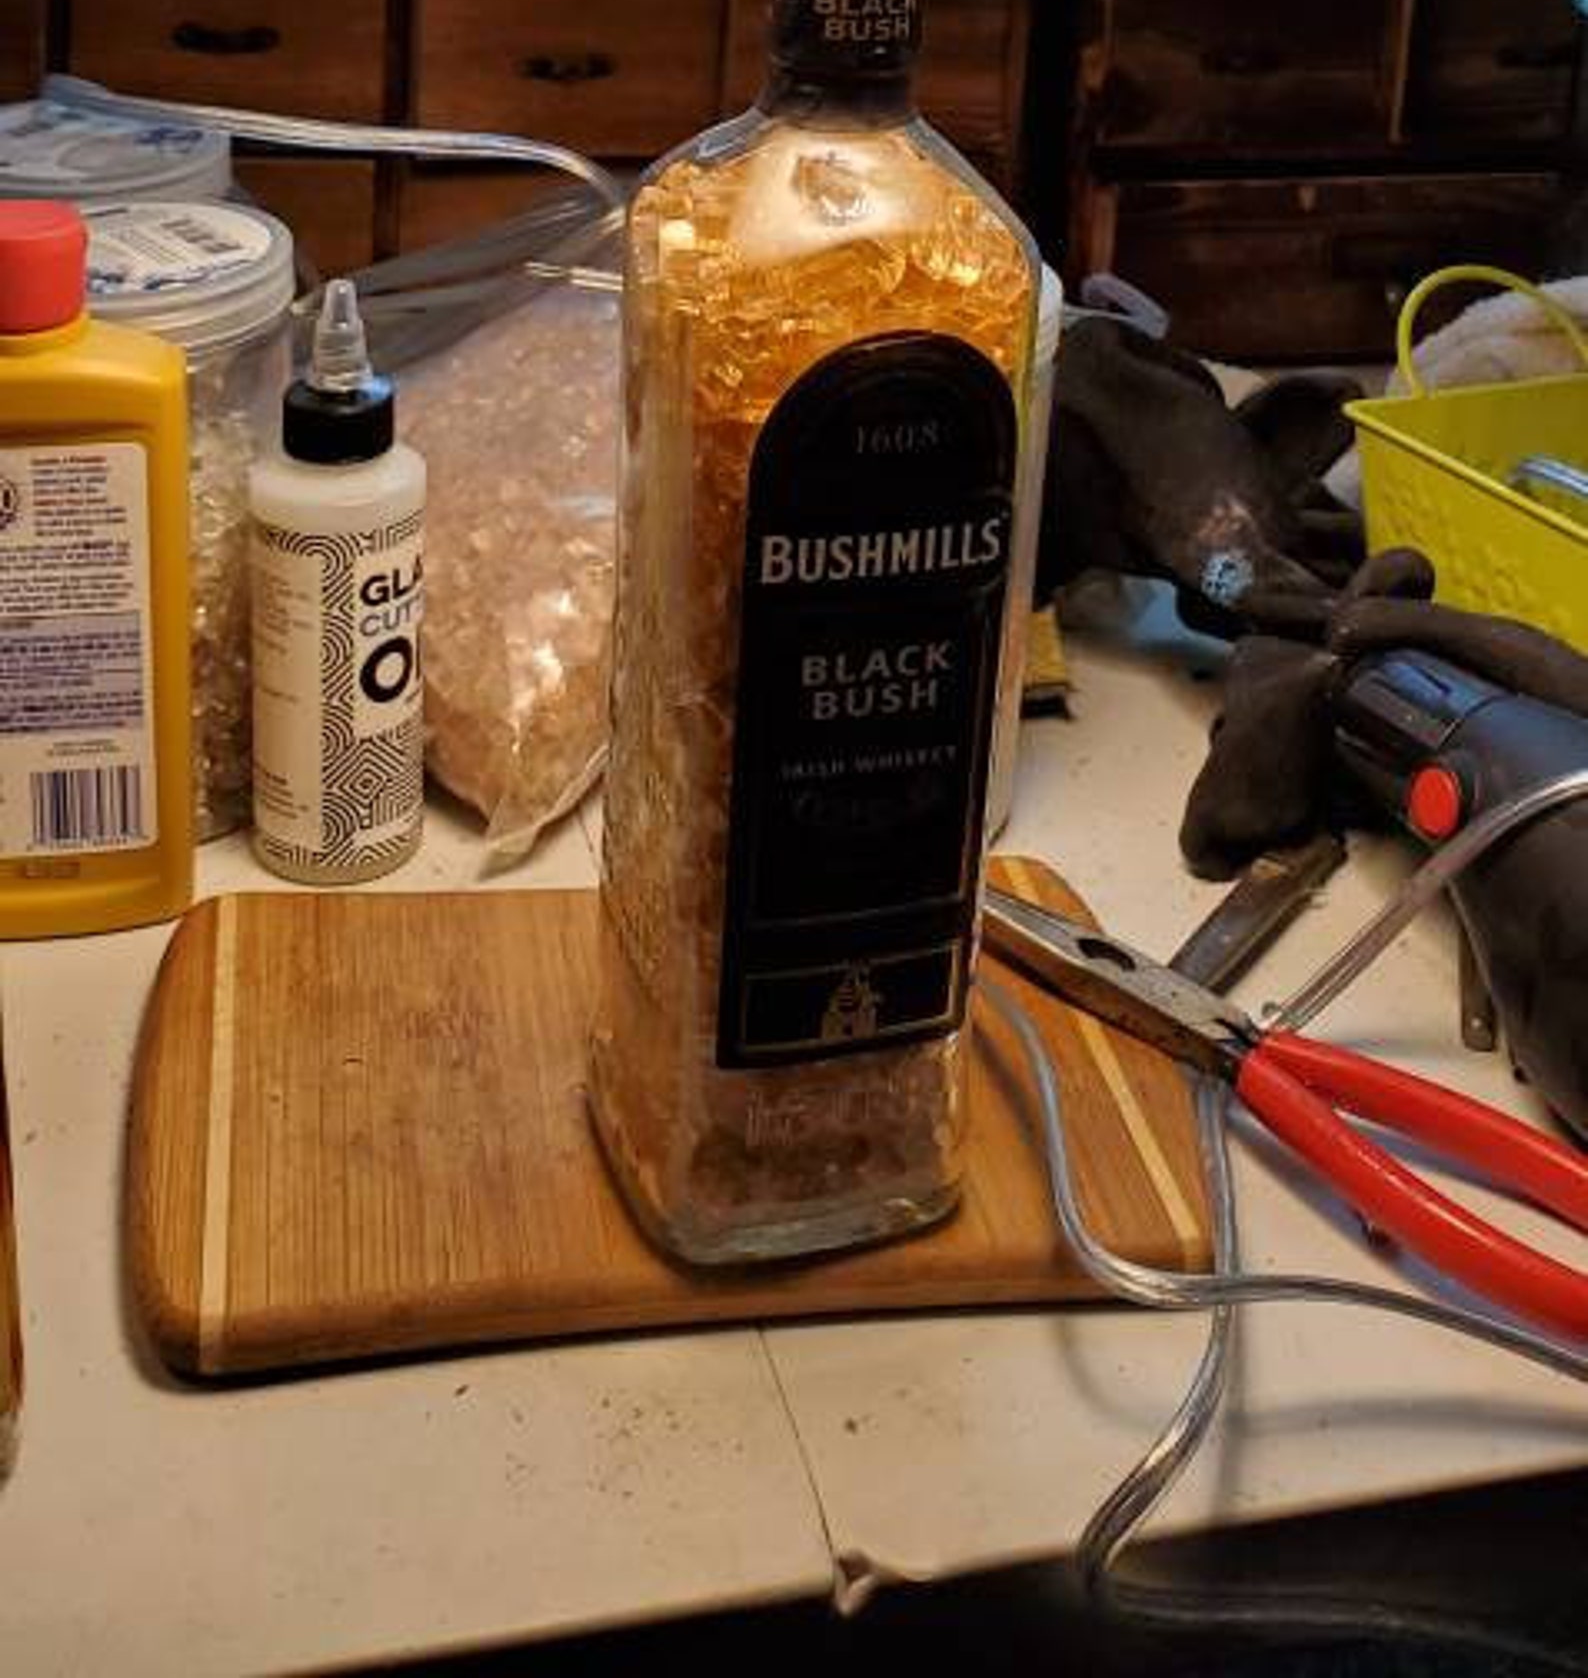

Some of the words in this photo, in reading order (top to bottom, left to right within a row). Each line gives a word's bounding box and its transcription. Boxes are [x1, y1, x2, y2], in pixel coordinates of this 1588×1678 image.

[825, 17, 909, 41] BUSH
[857, 420, 939, 454] 1608
[761, 519, 1000, 583] BUSHMILLS
[801, 639, 951, 687] BLACK
[813, 678, 937, 720] BUSH
